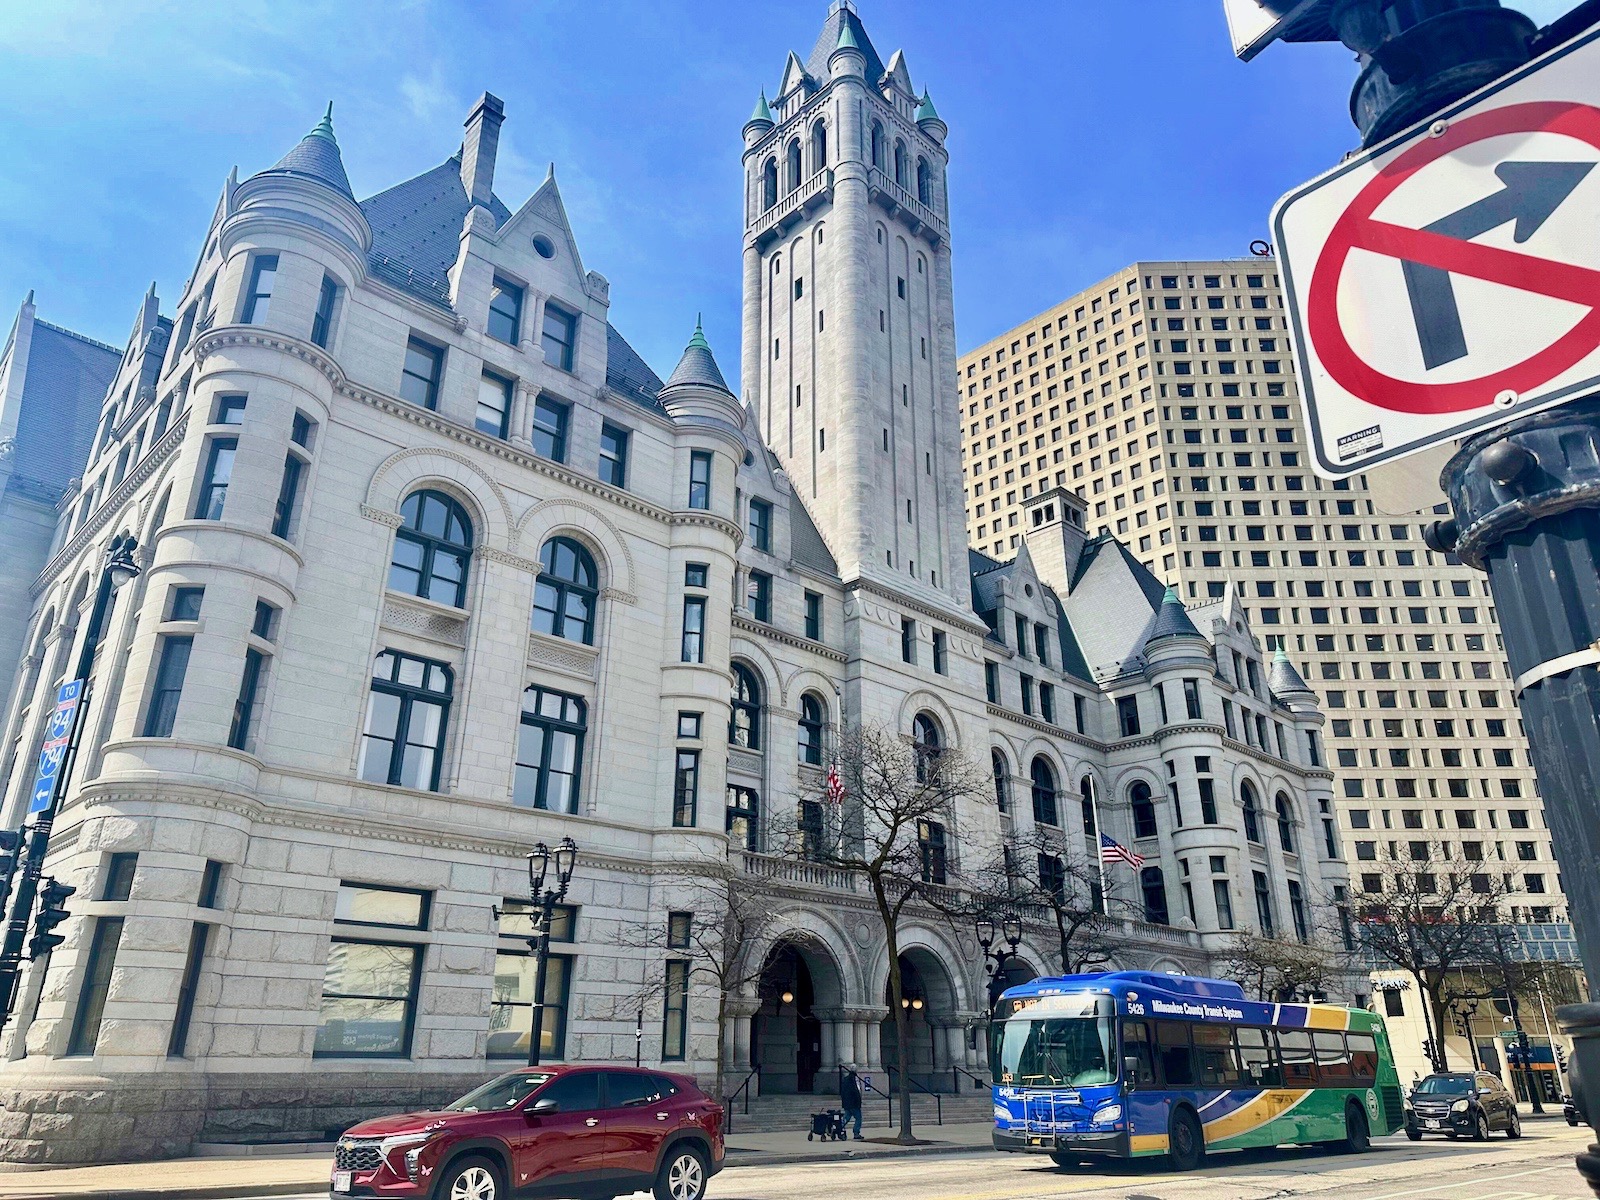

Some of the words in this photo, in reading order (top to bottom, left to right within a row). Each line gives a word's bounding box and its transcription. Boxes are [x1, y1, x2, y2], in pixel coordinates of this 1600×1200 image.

[1250, 240, 1274, 256] Q
[1340, 427, 1378, 444] WARNING
[65, 685, 75, 698] TO
[54, 709, 71, 732] 94
[41, 746, 63, 770] 794
[1127, 1003, 1144, 1015] 5426
[1152, 1000, 1183, 1014] Milwaukee
[1183, 1003, 1204, 1018] County
[1203, 1004, 1223, 1017] Transit
[1222, 1006, 1243, 1020] System
